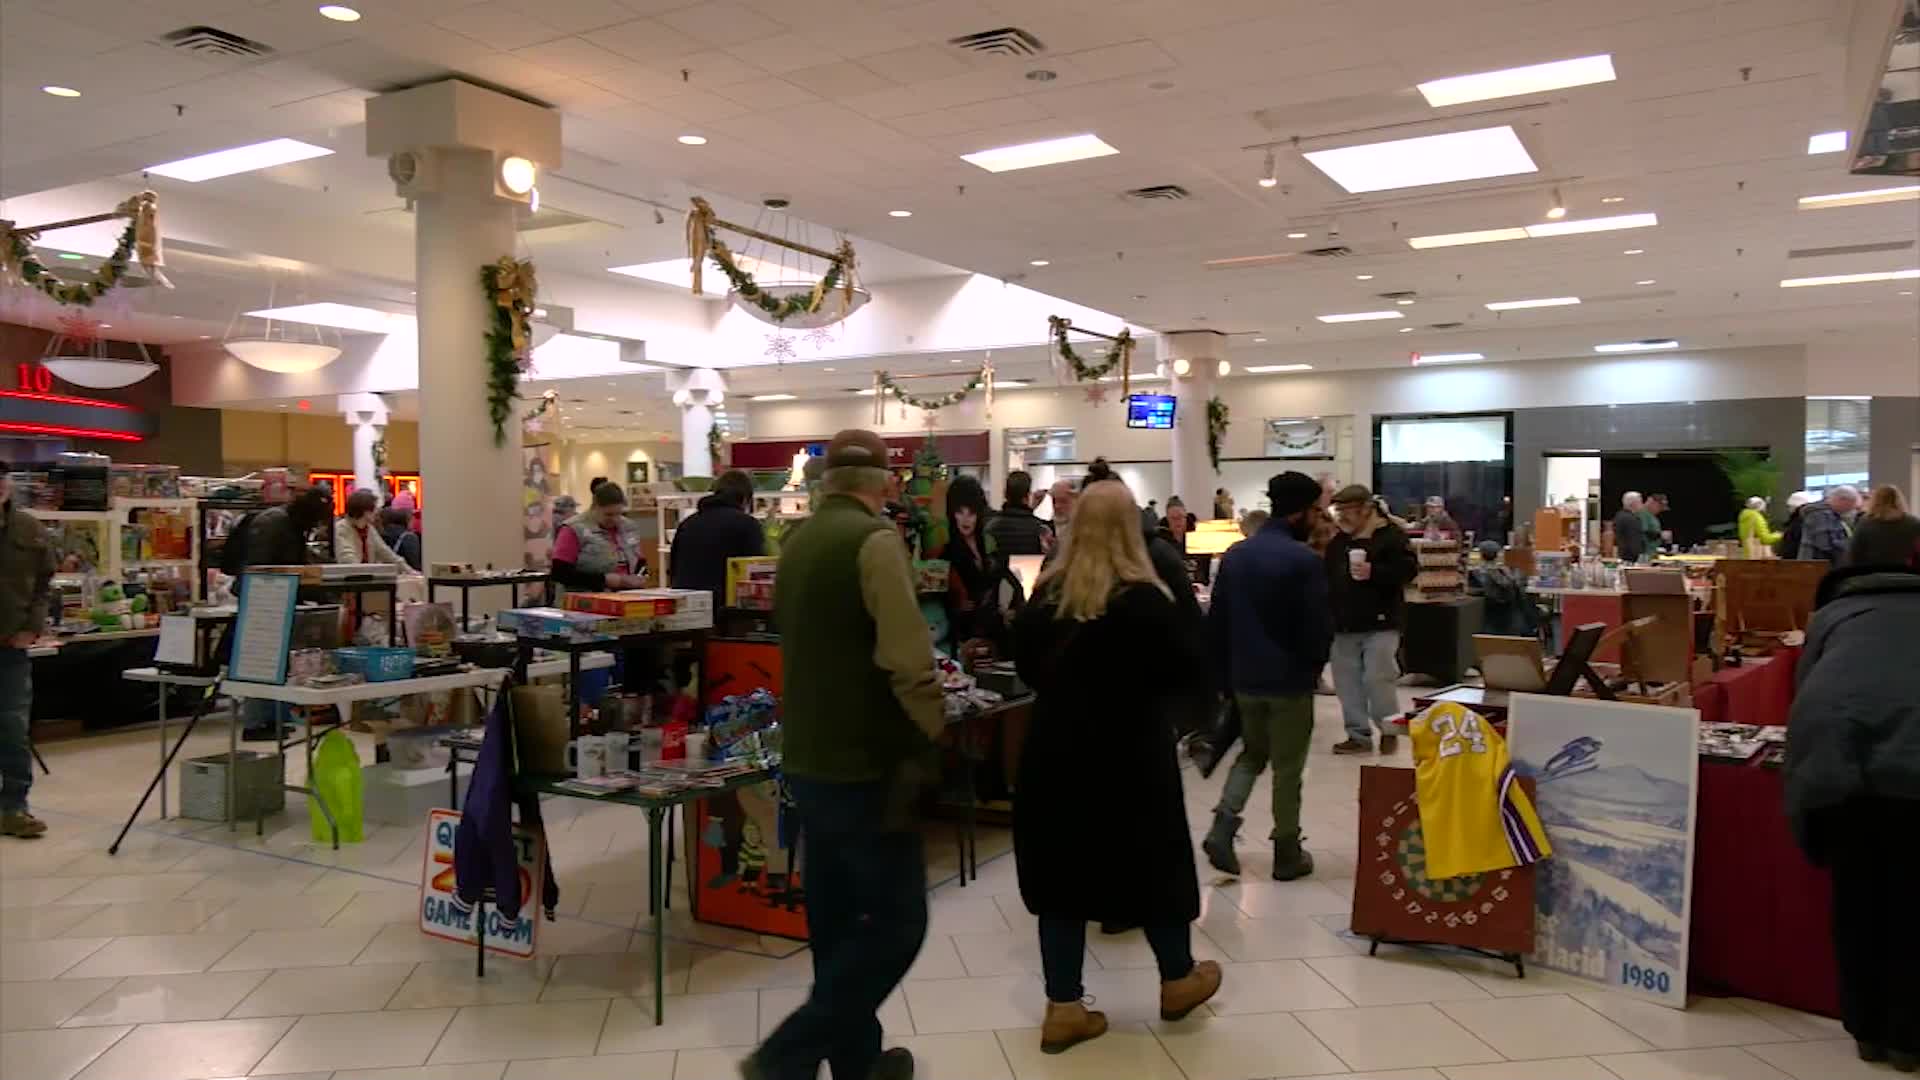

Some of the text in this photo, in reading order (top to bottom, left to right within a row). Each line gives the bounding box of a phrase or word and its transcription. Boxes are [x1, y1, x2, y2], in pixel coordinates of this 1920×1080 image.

[17, 363, 53, 393] 10
[1432, 709, 1487, 757] 24
[424, 896, 471, 930] GAME
[1621, 962, 1670, 993] 1980
